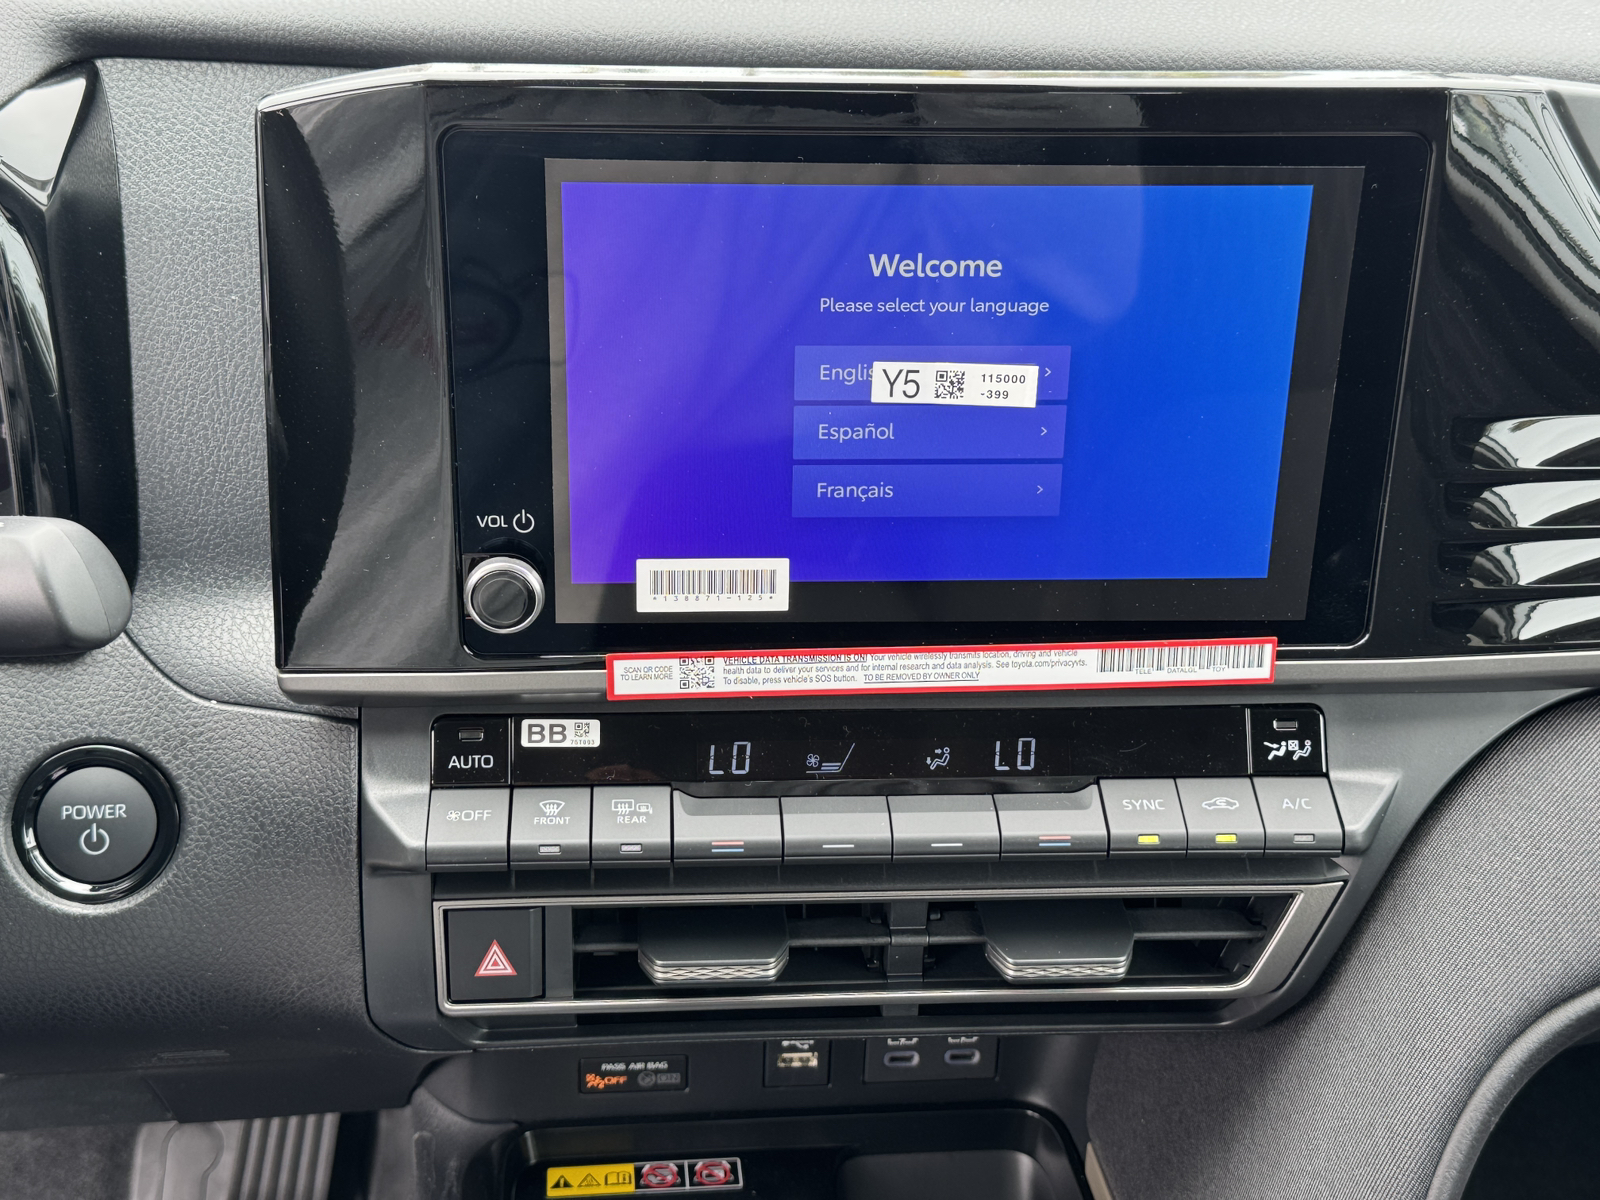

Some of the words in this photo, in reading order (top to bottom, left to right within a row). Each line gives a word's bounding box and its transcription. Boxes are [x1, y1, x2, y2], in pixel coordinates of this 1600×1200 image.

[868, 252, 1003, 278] Welcome
[819, 297, 873, 313] Please
[876, 298, 926, 313] select
[929, 300, 966, 316] your
[970, 297, 1050, 316] language
[819, 363, 873, 386] Englis
[980, 373, 1027, 384] 115000
[881, 368, 921, 399] Y5
[980, 389, 1010, 400] -399
[817, 422, 895, 443] Español
[816, 481, 894, 502] Français
[476, 514, 509, 528] VOL
[723, 656, 757, 665] VEHICLE
[759, 655, 780, 664] DATA
[782, 654, 842, 663] TRANSMISSION
[844, 653, 852, 662] IS
[870, 653, 886, 661] Your
[887, 652, 912, 661] vehicle
[913, 652, 948, 661] wirelessly
[949, 651, 981, 660] transmits
[982, 650, 1012, 659] location,
[1013, 649, 1036, 659] driving
[1038, 649, 1052, 658] and
[1053, 649, 1078, 658] vehicle
[623, 666, 641, 674] SCAN
[654, 665, 673, 673] CODE
[723, 666, 745, 675] health
[746, 666, 762, 675] data
[763, 666, 771, 674] to
[772, 665, 796, 674] deliver
[797, 666, 813, 675] your
[815, 665, 845, 673] services
[845, 664, 859, 672] and
[860, 663, 870, 671] for
[871, 662, 898, 671] internal
[899, 662, 930, 671] research
[931, 661, 945, 670] and
[946, 661, 962, 670] data
[963, 660, 994, 670] analysis.
[995, 660, 1010, 668] See
[620, 673, 630, 681] TO
[631, 673, 653, 681] LEARN
[653, 672, 673, 680] MORE
[723, 676, 732, 685] To
[733, 676, 761, 685] disable,
[762, 676, 782, 685] press
[783, 675, 813, 684] vehicle's
[815, 674, 832, 683] SOS
[833, 673, 857, 682] button.
[864, 673, 874, 681] TO
[874, 673, 885, 681] BE
[885, 672, 922, 681] REMOVED
[922, 672, 933, 680] BY
[933, 671, 961, 680] OWNER
[961, 671, 981, 679] ONLY
[527, 723, 568, 744] BB
[448, 754, 495, 769] AUTO
[1121, 799, 1166, 811] SYNC
[1281, 798, 1313, 810] A/C
[60, 803, 127, 820] POWER
[461, 809, 492, 822] OFF
[533, 816, 571, 825] FRONT
[616, 815, 647, 824] REAR
[601, 1062, 627, 1072] PASS
[627, 1061, 646, 1071] AIR
[604, 1075, 628, 1085] OFF
